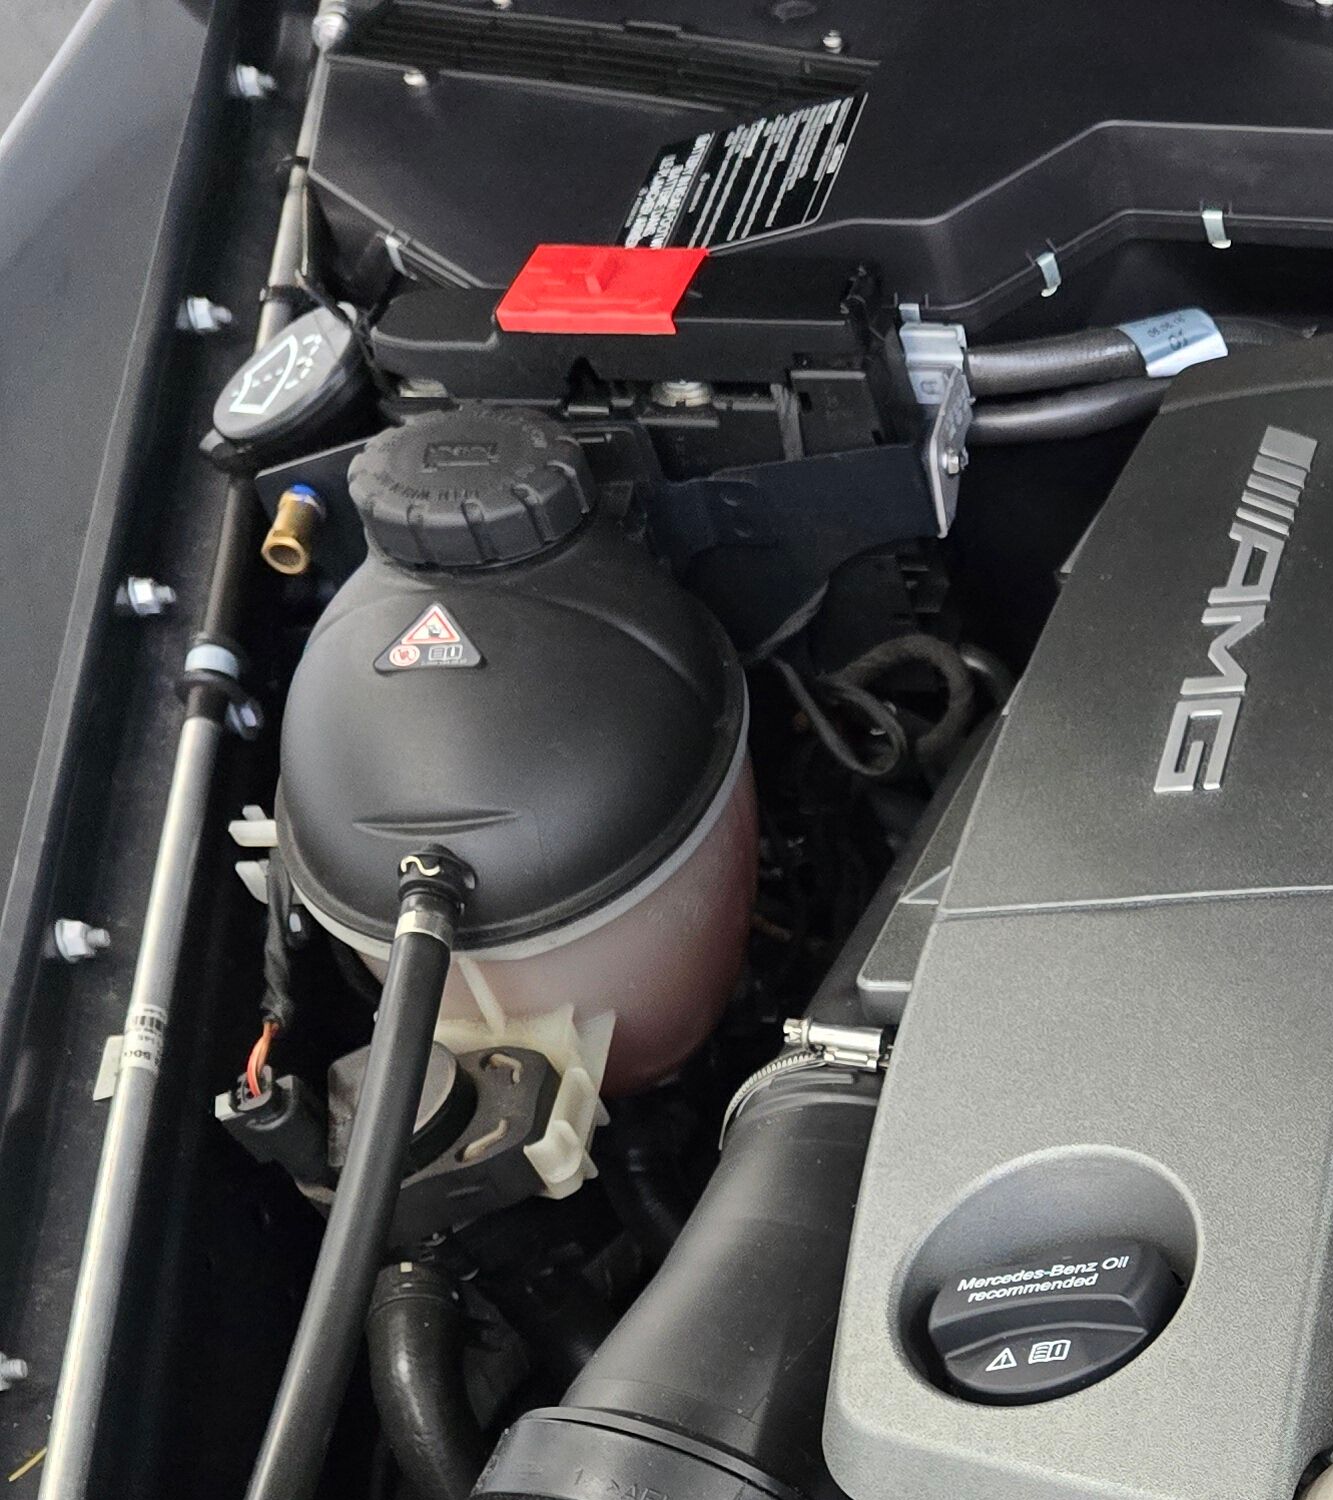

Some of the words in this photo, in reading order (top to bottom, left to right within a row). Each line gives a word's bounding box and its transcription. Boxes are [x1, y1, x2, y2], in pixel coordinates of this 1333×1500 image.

[1153, 522, 1286, 793] AMG
[957, 1261, 1098, 1292] Mercedes-Benz
[1101, 1256, 1130, 1271] Oil
[968, 1273, 1099, 1303] recommended
